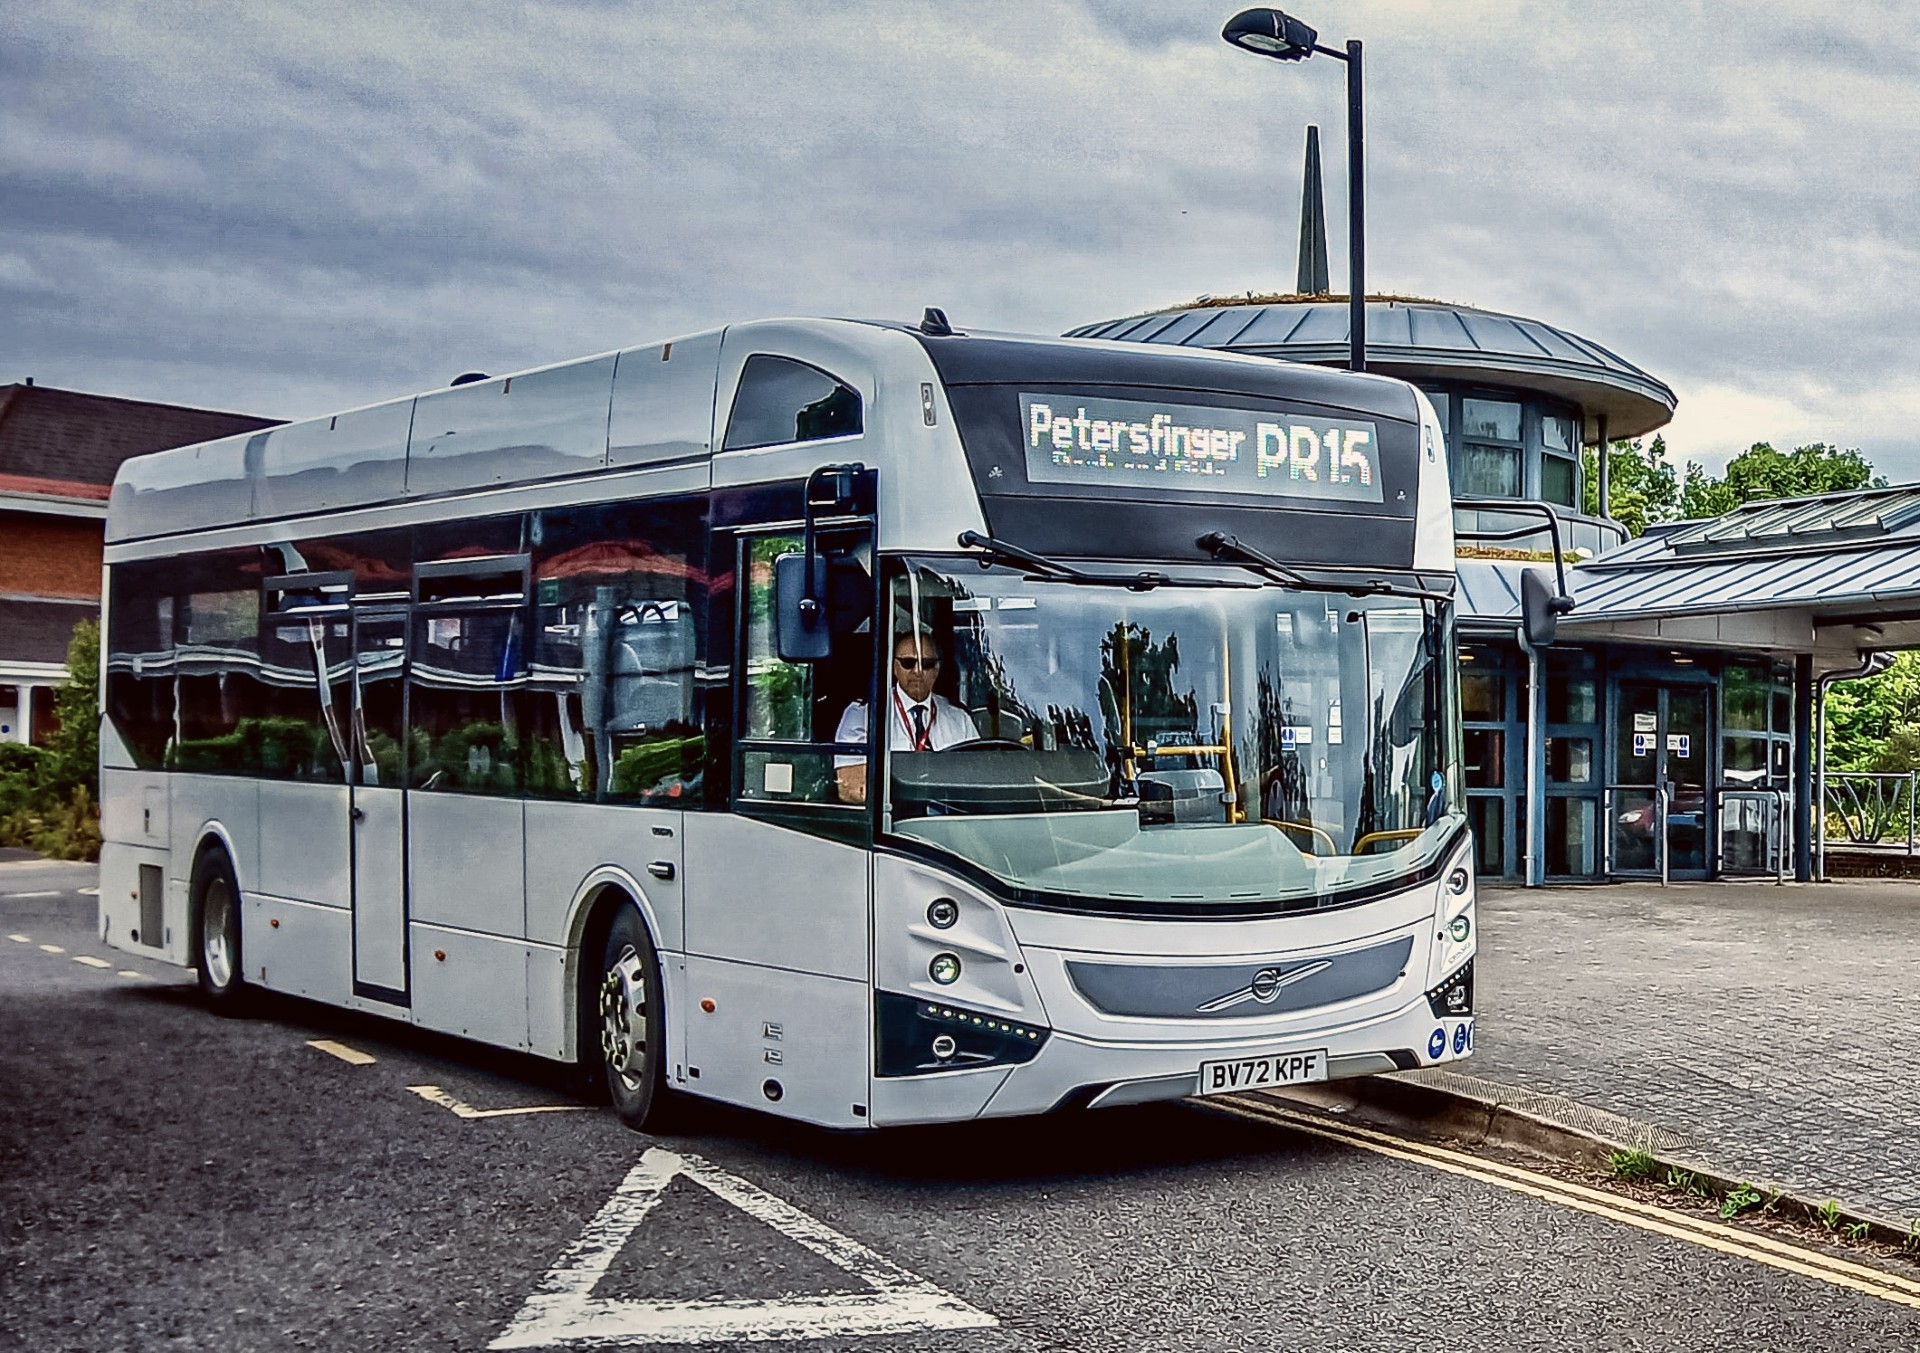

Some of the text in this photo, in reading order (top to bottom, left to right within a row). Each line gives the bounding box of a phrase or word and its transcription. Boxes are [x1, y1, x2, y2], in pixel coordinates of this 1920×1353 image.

[1030, 403, 1247, 462] Petersfinger
[1256, 422, 1373, 486] PR15
[1212, 1055, 1317, 1088] BV72 KPF
